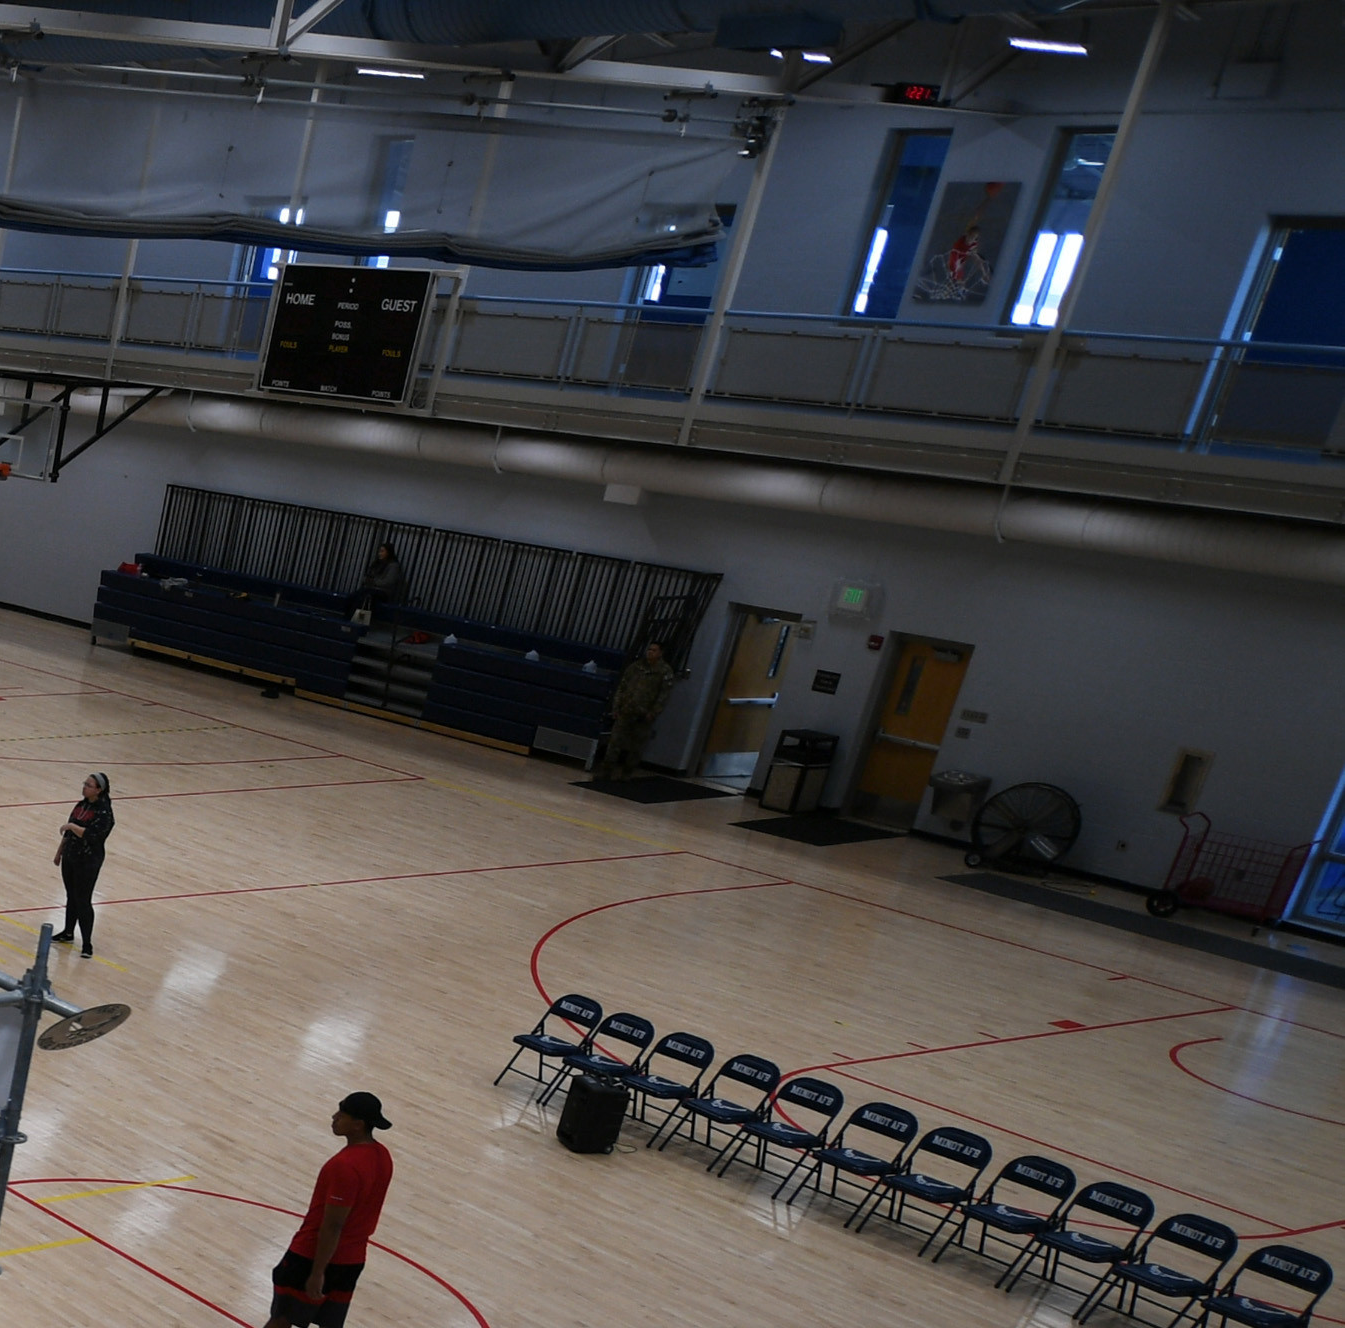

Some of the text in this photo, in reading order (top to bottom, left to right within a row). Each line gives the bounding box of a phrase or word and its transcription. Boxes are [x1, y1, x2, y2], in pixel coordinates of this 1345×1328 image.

[285, 292, 316, 306] HOME
[336, 302, 360, 311] PERIOD
[380, 298, 418, 313] GUEST
[331, 332, 350, 341] BONUS
[279, 340, 298, 350] FOULS
[328, 344, 350, 354] PLAYER
[381, 349, 402, 359] FOULS
[271, 379, 290, 389] POINTS
[371, 389, 391, 399] POINTS
[731, 1062, 771, 1083] MINOT AFB
[790, 1085, 834, 1107] MINOT AFB
[862, 1110, 908, 1133] MINOT AFB
[932, 1135, 982, 1159] MINOT AFB
[1015, 1163, 1065, 1189] MINOT AFB
[1089, 1190, 1143, 1217] MINOT AFB
[1170, 1222, 1226, 1249] MINOT AFB
[1262, 1253, 1321, 1282] MINOT AFB
